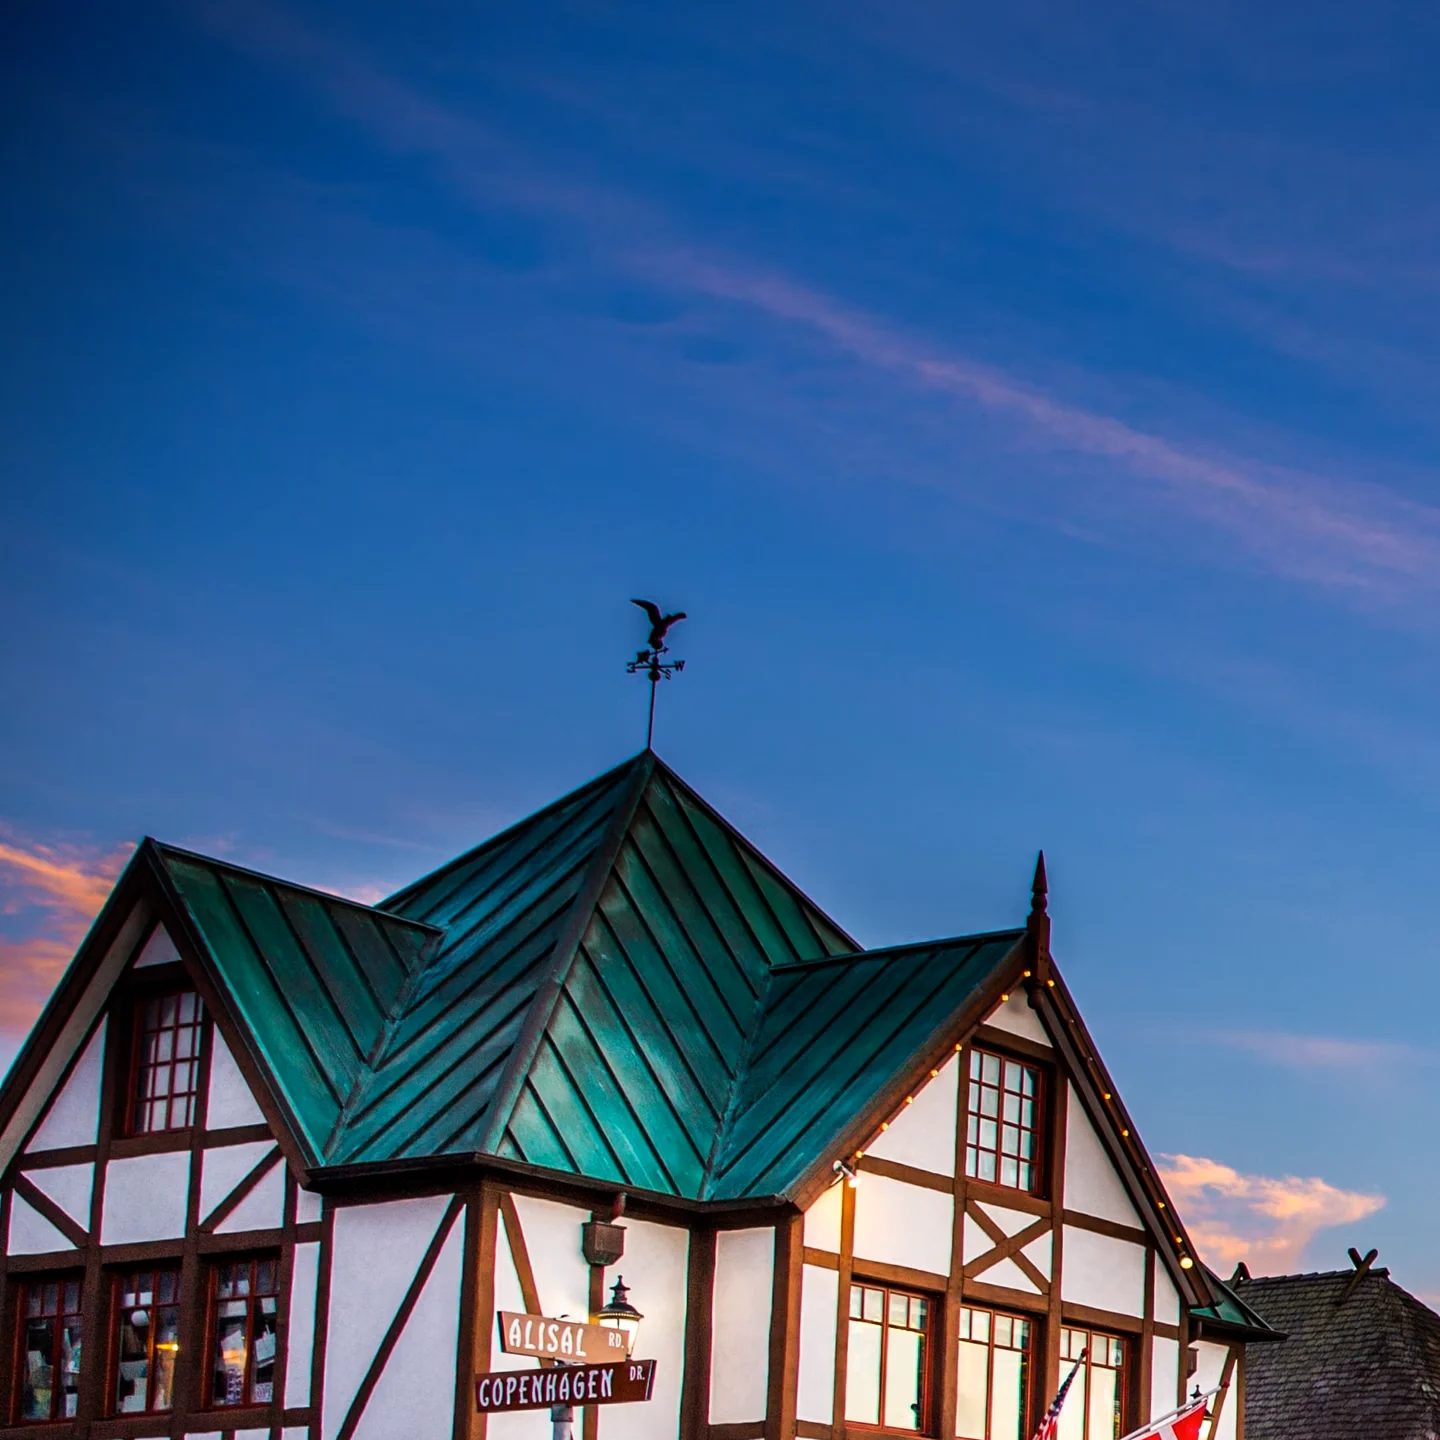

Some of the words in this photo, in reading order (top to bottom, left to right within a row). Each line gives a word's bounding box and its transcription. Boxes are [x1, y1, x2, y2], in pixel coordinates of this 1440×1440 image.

[509, 1318, 587, 1357] ALISAL
[608, 1332, 625, 1349] RD.
[479, 1368, 614, 1407] COPENHAGEN
[629, 1365, 646, 1381] DR.
